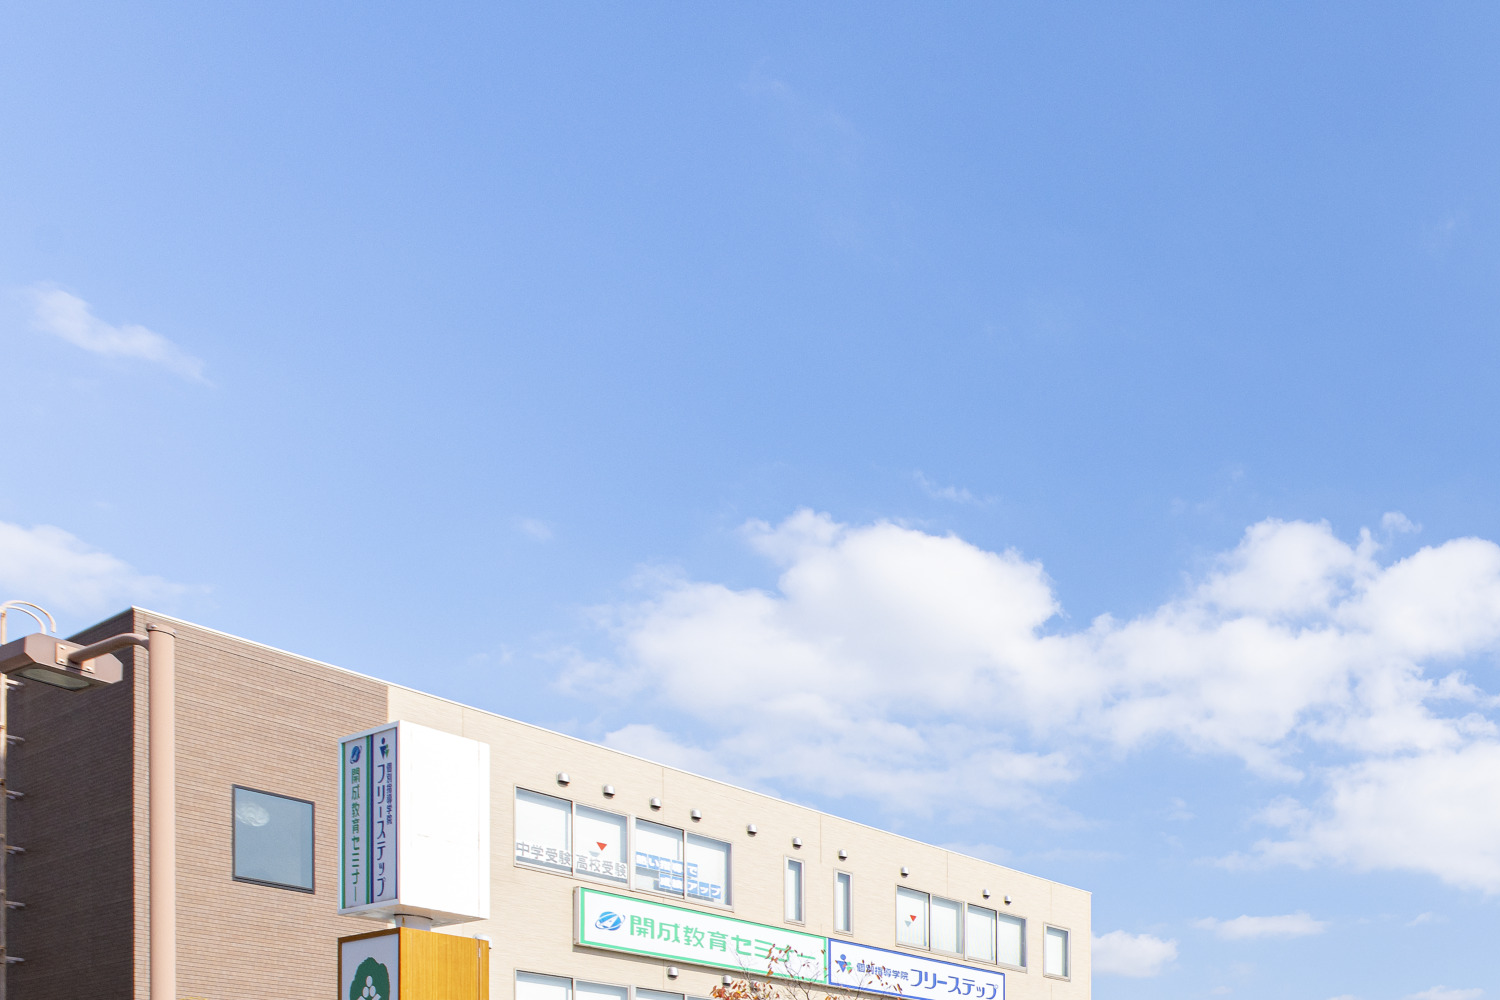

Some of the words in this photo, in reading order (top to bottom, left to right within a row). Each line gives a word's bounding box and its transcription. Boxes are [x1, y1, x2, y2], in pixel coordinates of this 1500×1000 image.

[351, 767, 361, 902] 開成教育セミナー
[376, 763, 387, 897] フリーステップ
[515, 841, 572, 867] 中学受験
[575, 853, 628, 878] 高校受験
[629, 914, 816, 962] 開成教育セミナー
[910, 968, 999, 1000] フリーステップ
